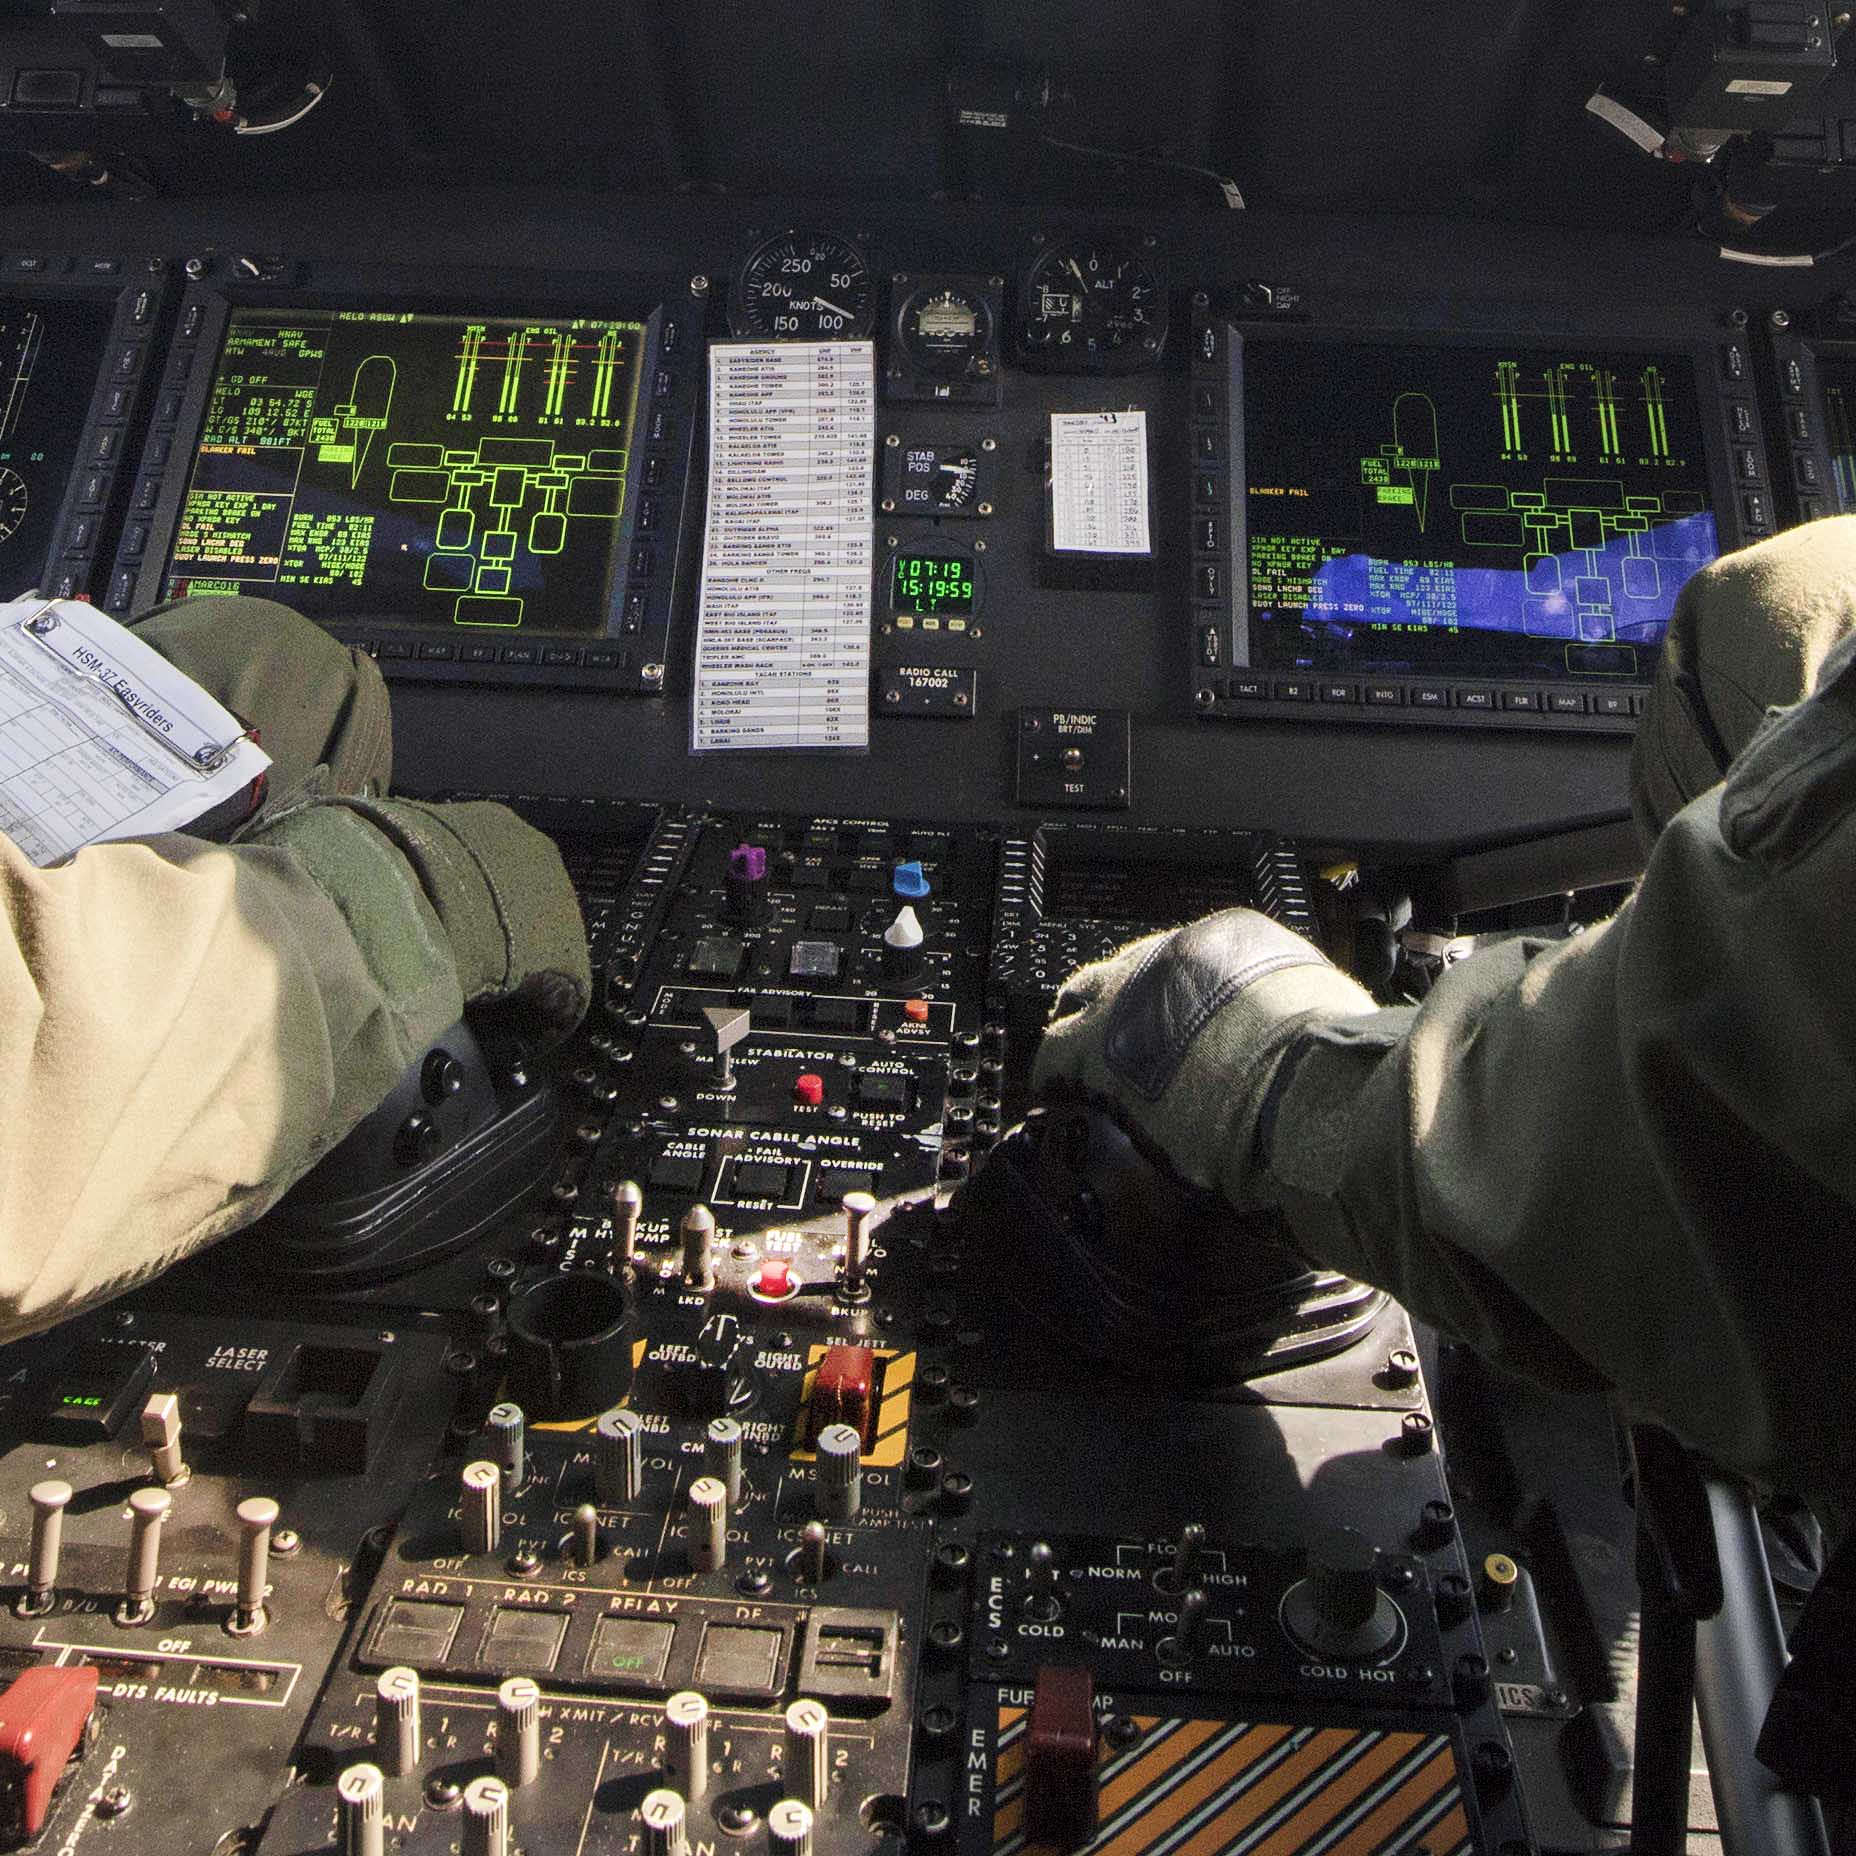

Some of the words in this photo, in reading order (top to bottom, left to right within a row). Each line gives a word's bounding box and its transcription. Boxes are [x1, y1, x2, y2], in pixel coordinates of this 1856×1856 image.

[781, 259, 811, 272] 250
[830, 274, 850, 288] 50
[1095, 280, 1115, 288] ALT
[762, 282, 792, 297] 200
[789, 301, 824, 311] KNOTS
[774, 316, 798, 331] 150
[819, 315, 843, 329] 100
[283, 340, 307, 348] SAFE
[907, 451, 934, 461] STAB
[909, 463, 930, 473] POS
[906, 490, 928, 500] DEG
[1289, 489, 1309, 497] FAIL
[910, 561, 961, 578] 07:19
[902, 580, 972, 598] 15:19:59
[900, 668, 929, 678] RADIO
[933, 668, 958, 678] CALL
[909, 678, 949, 688] 167002
[72, 645, 116, 686] HSM-37
[112, 677, 174, 734] Easyriders
[1558, 698, 1576, 706] MAP
[1053, 714, 1096, 726] PB/INDIC
[1058, 725, 1092, 734] BRT/DIM
[1064, 783, 1085, 793] TEST
[748, 1049, 834, 1060] STABILATOR
[872, 1060, 904, 1068] AUTO
[859, 1067, 915, 1075] CONTROL
[687, 1128, 743, 1139] SONAR
[750, 1132, 799, 1143] CABLE
[805, 1136, 860, 1146] ANGLE
[820, 1159, 884, 1169] OVERRIDE
[214, 1345, 268, 1360] LASER
[659, 1345, 689, 1354] LEFT
[206, 1355, 266, 1371] SELECT
[649, 1352, 696, 1362] OUTBD
[1088, 1567, 1141, 1580] NORM
[1203, 1573, 1246, 1585] HIGH
[402, 1579, 448, 1595] RAD
[1018, 1625, 1064, 1637] COLD
[1300, 1665, 1348, 1681] COLD
[1359, 1667, 1395, 1683] HOT
[112, 1684, 149, 1701] DTS
[155, 1686, 219, 1705] FAULTS
[556, 1708, 607, 1725] XMIT
[967, 1730, 987, 1815] EMER
